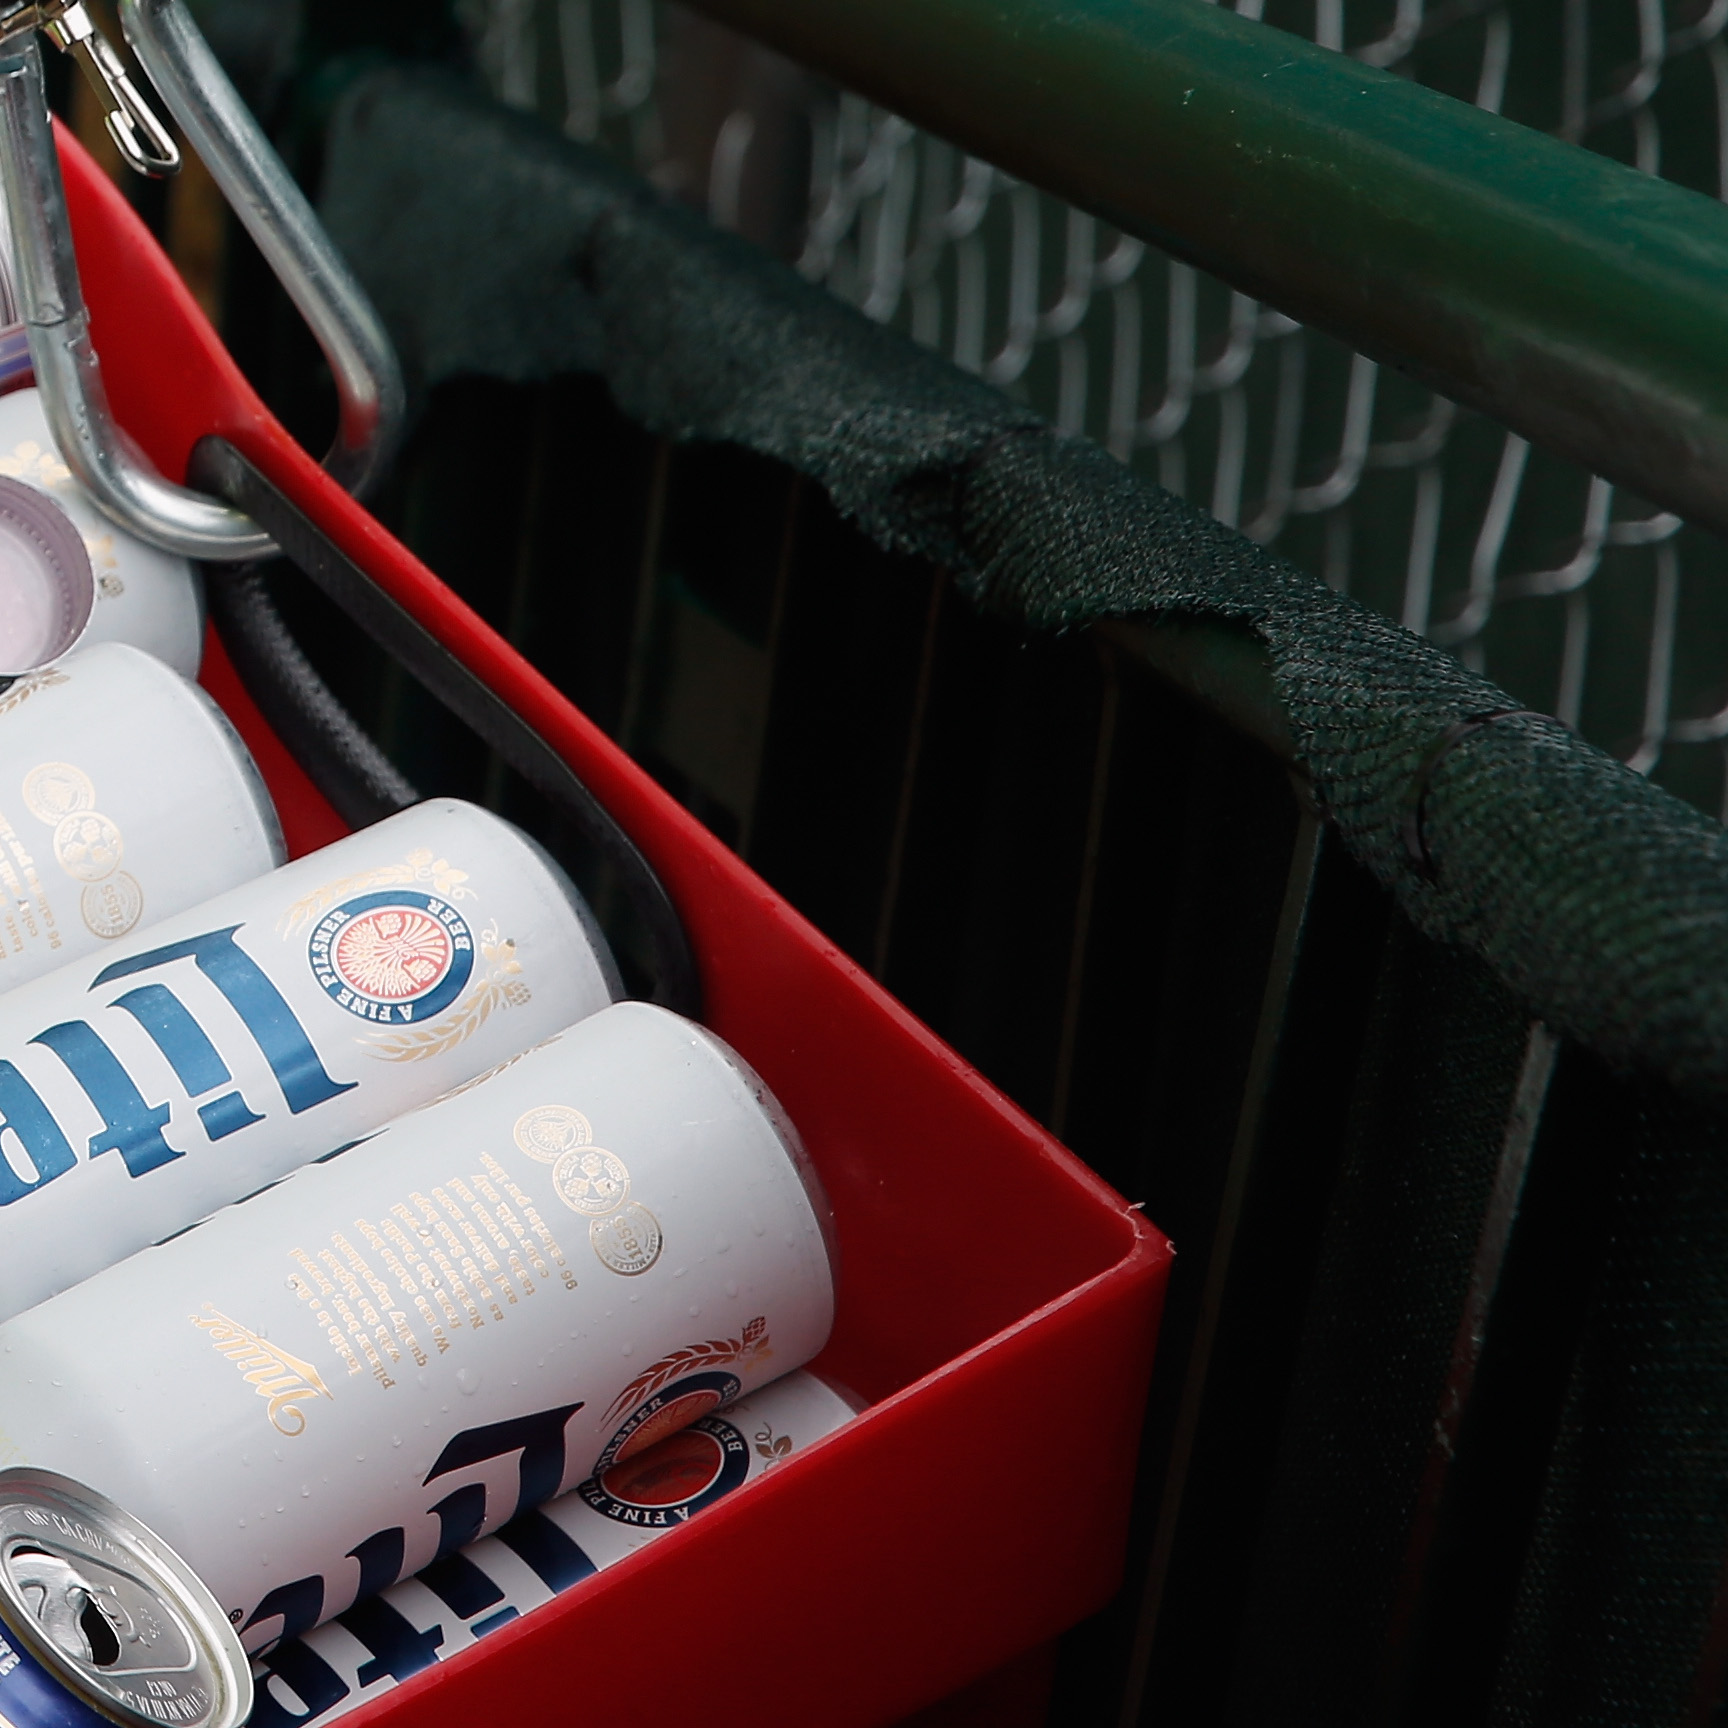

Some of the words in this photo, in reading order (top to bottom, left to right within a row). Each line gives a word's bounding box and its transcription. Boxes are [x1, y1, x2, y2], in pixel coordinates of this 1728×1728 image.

[426, 898, 470, 950] BEER
[311, 909, 350, 988] PILSNER
[336, 988, 391, 1021] FINE
[397, 1004, 412, 1020] A
[407, 1190, 441, 1227] hops
[430, 1186, 465, 1226] more
[445, 1176, 475, 1209] and
[469, 1168, 502, 1208] only
[503, 1182, 532, 1212] per
[352, 1217, 386, 1251] hops
[389, 1201, 420, 1237] well
[470, 1201, 510, 1249] aroma
[518, 1206, 566, 1267] calories
[610, 1214, 646, 1263] 1855
[379, 1217, 421, 1267] Pacific
[458, 1220, 499, 1274] deliver
[288, 1246, 335, 1299] brewed
[317, 1247, 365, 1303] highest
[379, 1244, 419, 1295] choice
[428, 1247, 485, 1329] Northwest
[455, 1254, 493, 1300] noble
[493, 1271, 519, 1305] and
[559, 1269, 578, 1291] 96
[331, 1290, 364, 1334] beer,
[352, 1297, 380, 1327] the
[413, 1294, 437, 1326] use
[433, 1287, 462, 1329] from
[326, 1323, 362, 1376] Inside
[373, 1323, 401, 1363] with
[384, 1310, 428, 1368] quality
[430, 1323, 450, 1355] We
[188, 1300, 336, 1438] Miller
[354, 1333, 396, 1390] pilsner
[608, 1504, 667, 1524] FINE
